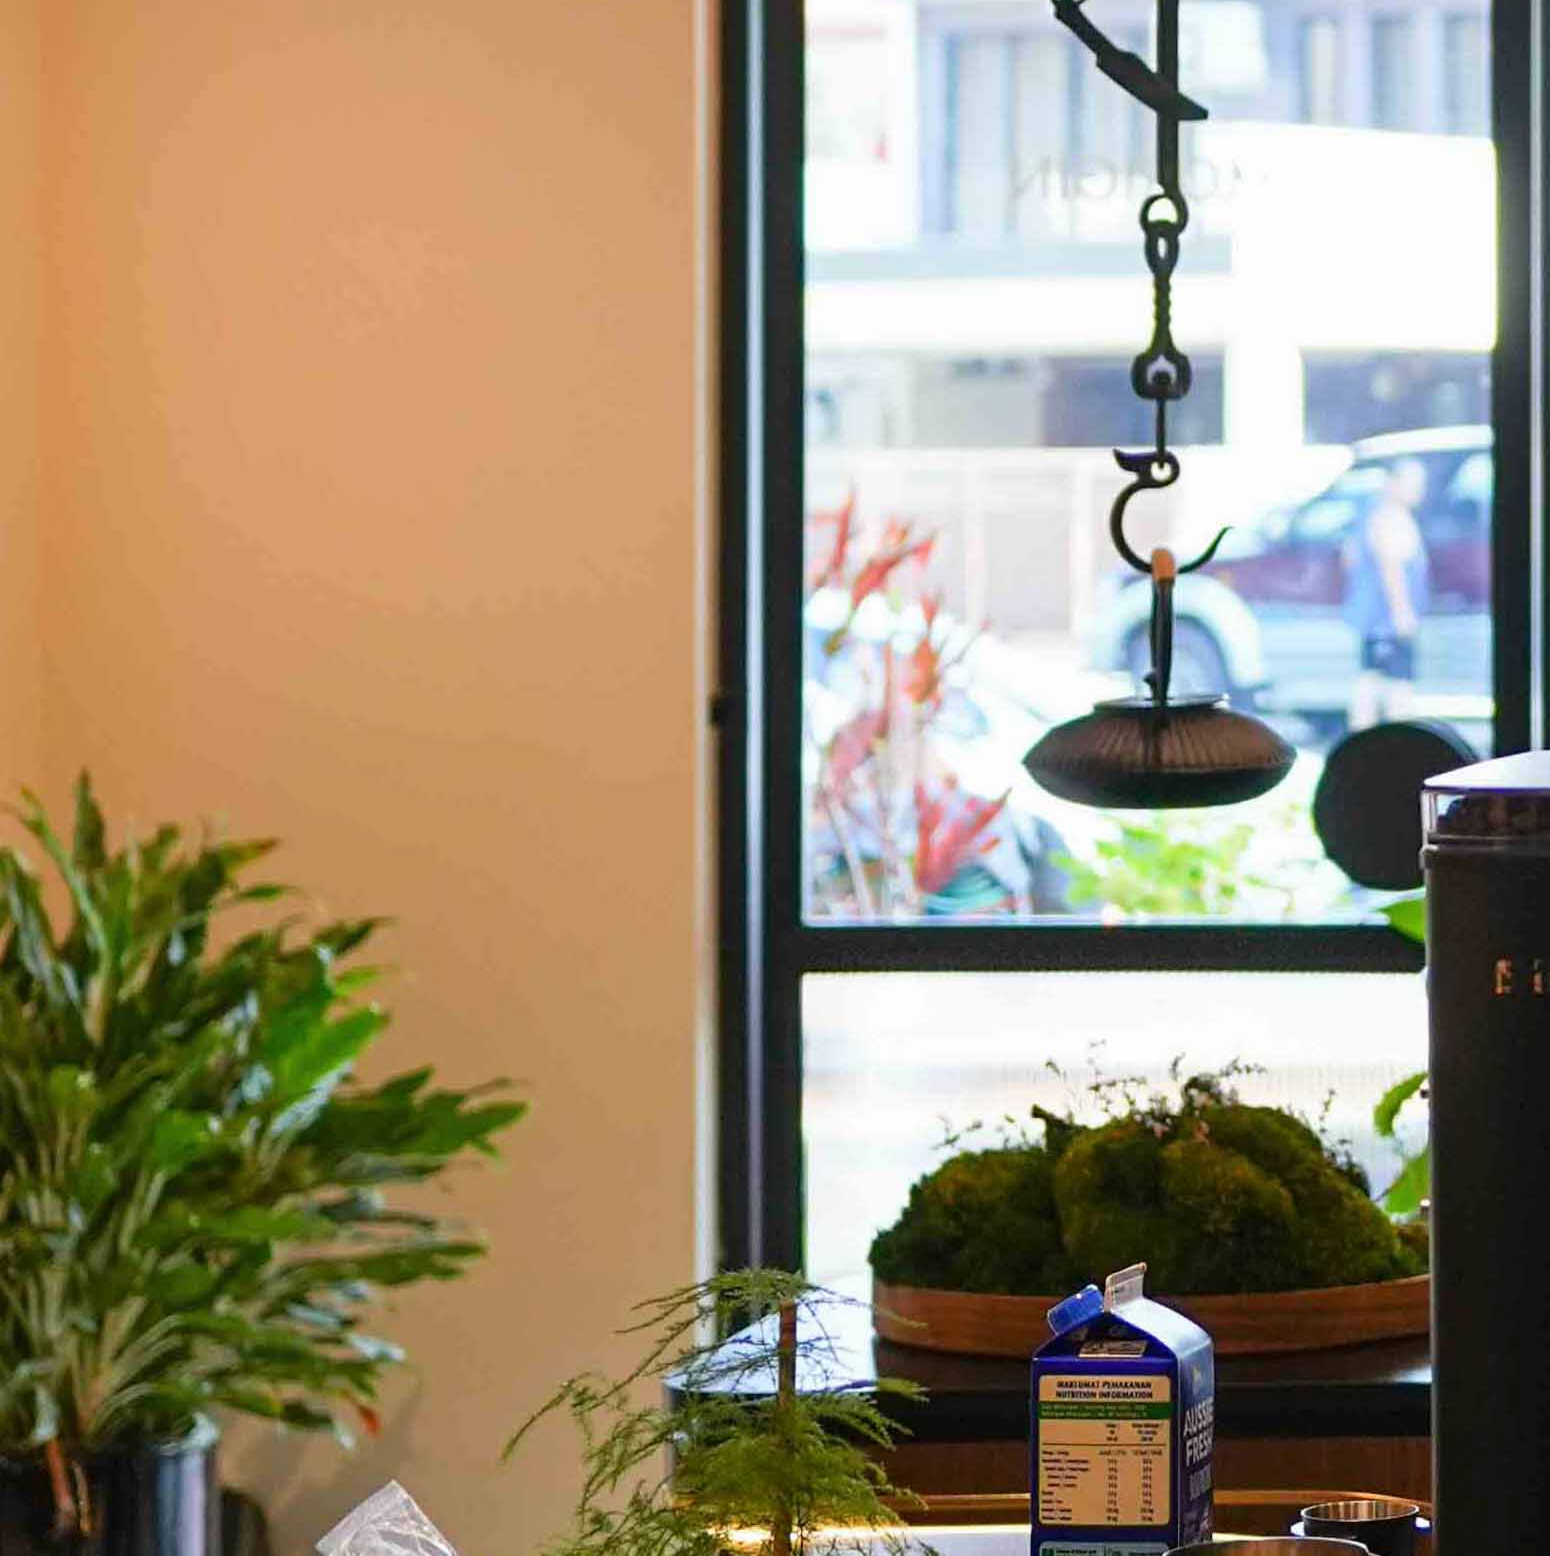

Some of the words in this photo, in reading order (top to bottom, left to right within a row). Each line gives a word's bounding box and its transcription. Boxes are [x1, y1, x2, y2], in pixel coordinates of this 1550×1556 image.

[1055, 1390, 1098, 1400] NUTRITION
[1098, 1390, 1153, 1400] INFORMATION
[1186, 1426, 1213, 1467] FRESH
